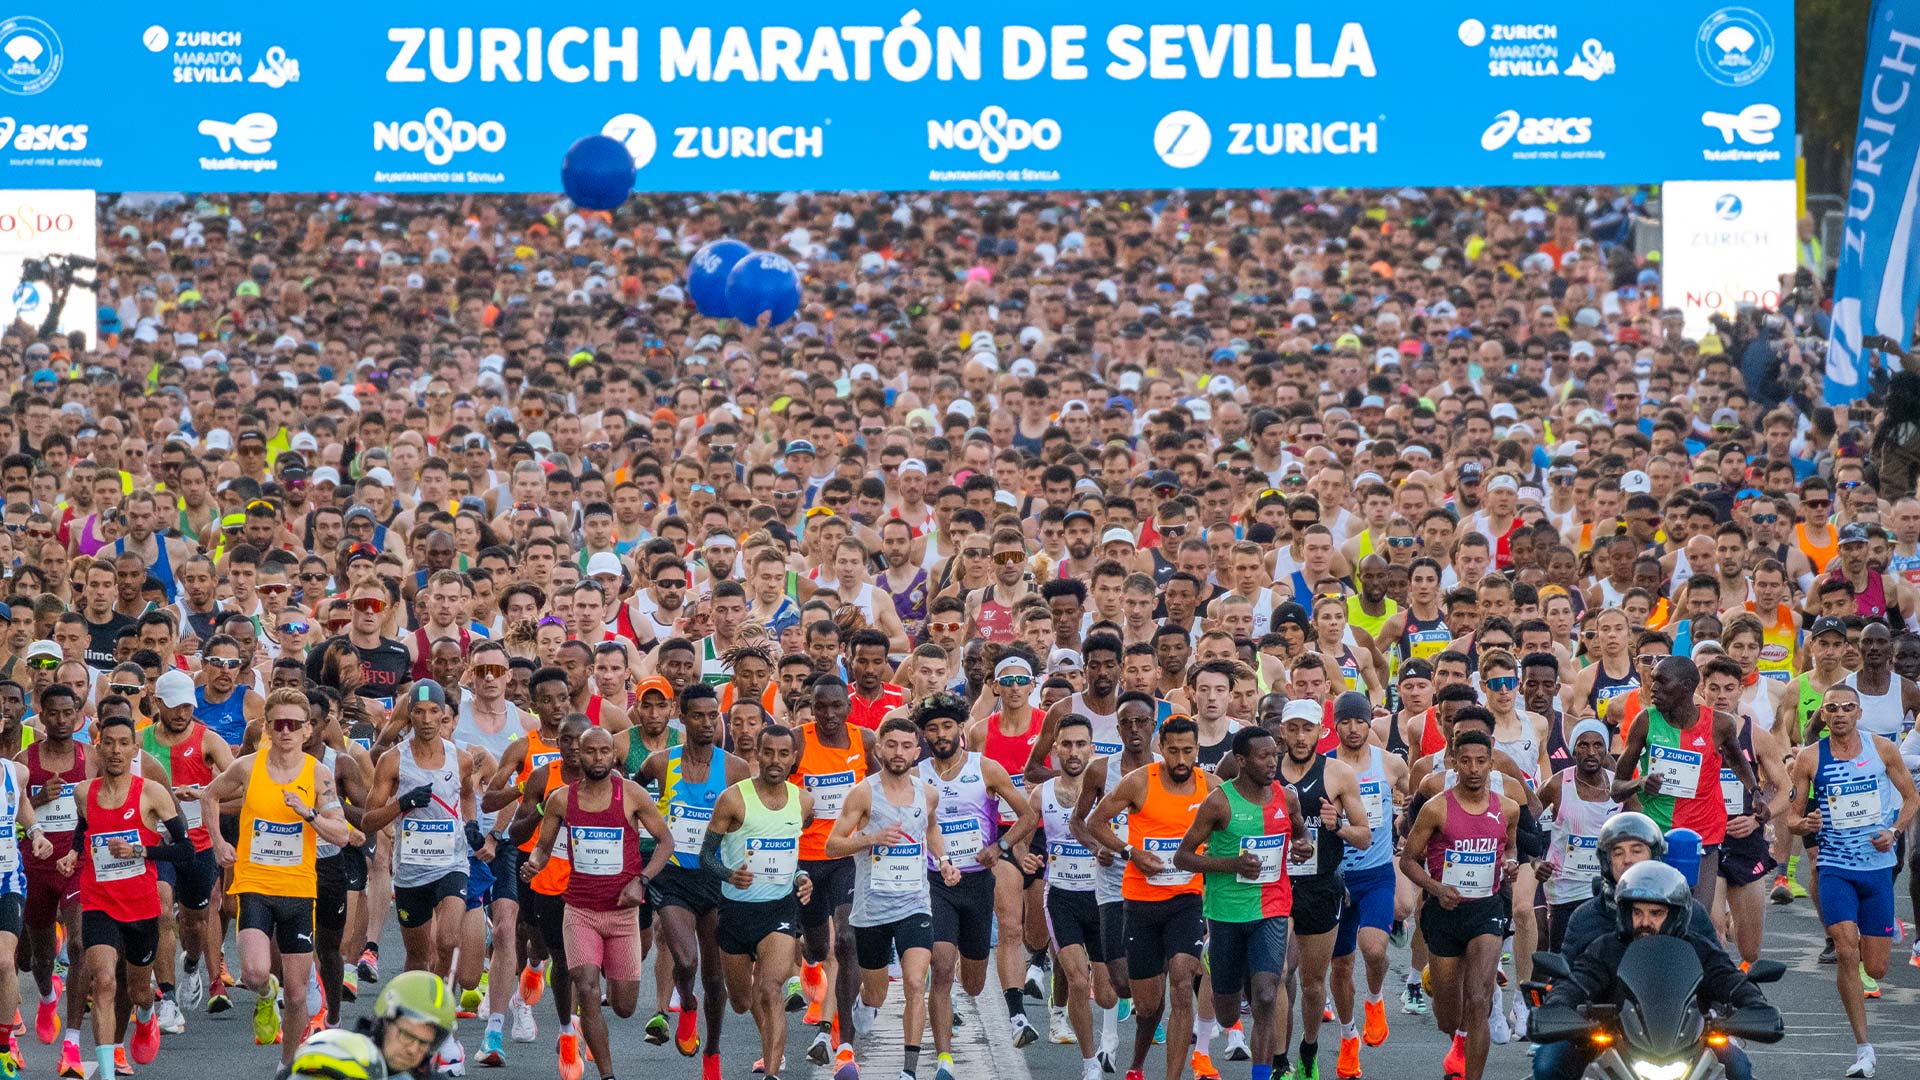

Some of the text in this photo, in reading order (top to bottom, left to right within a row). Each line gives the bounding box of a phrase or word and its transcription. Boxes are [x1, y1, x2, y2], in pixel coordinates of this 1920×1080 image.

[1491, 24, 1557, 40] ZURICH
[176, 31, 242, 47] ZURICH
[386, 8, 1377, 83] ZURICH MARATÓN DE SEVILLA
[174, 50, 242, 66] MARATÓN
[1488, 60, 1559, 76] SEVILLA
[173, 66, 243, 83] SEVILLA
[1516, 117, 1592, 144] asics
[13, 124, 89, 151] asics
[673, 126, 822, 158] ZURICH
[1227, 121, 1378, 154] ZURICH
[1844, 28, 1920, 268] ZURICH
[1702, 149, 1781, 163] TotalEnergies
[199, 157, 278, 172] TotalEnergies
[1689, 231, 1769, 247] ZURICH
[1095, 744, 1117, 753] URICH
[1667, 751, 1695, 763] ZURICH
[1668, 767, 1677, 775] 38
[822, 775, 849, 786] ZURICH
[1844, 783, 1872, 793] ZURICH
[271, 824, 299, 834] ZURICH
[421, 822, 449, 831] ZURICH
[945, 822, 973, 833] ZURICH
[588, 830, 617, 839] ZURICH
[274, 840, 283, 848] 78
[423, 838, 433, 846] 60
[765, 840, 791, 849] ZURICH
[1162, 841, 1180, 849] ZURI
[1454, 838, 1498, 853] POLIZIA
[261, 849, 294, 857] LINKLETTER
[892, 846, 917, 855] ZURICH
[1464, 855, 1491, 863] ZURICH
